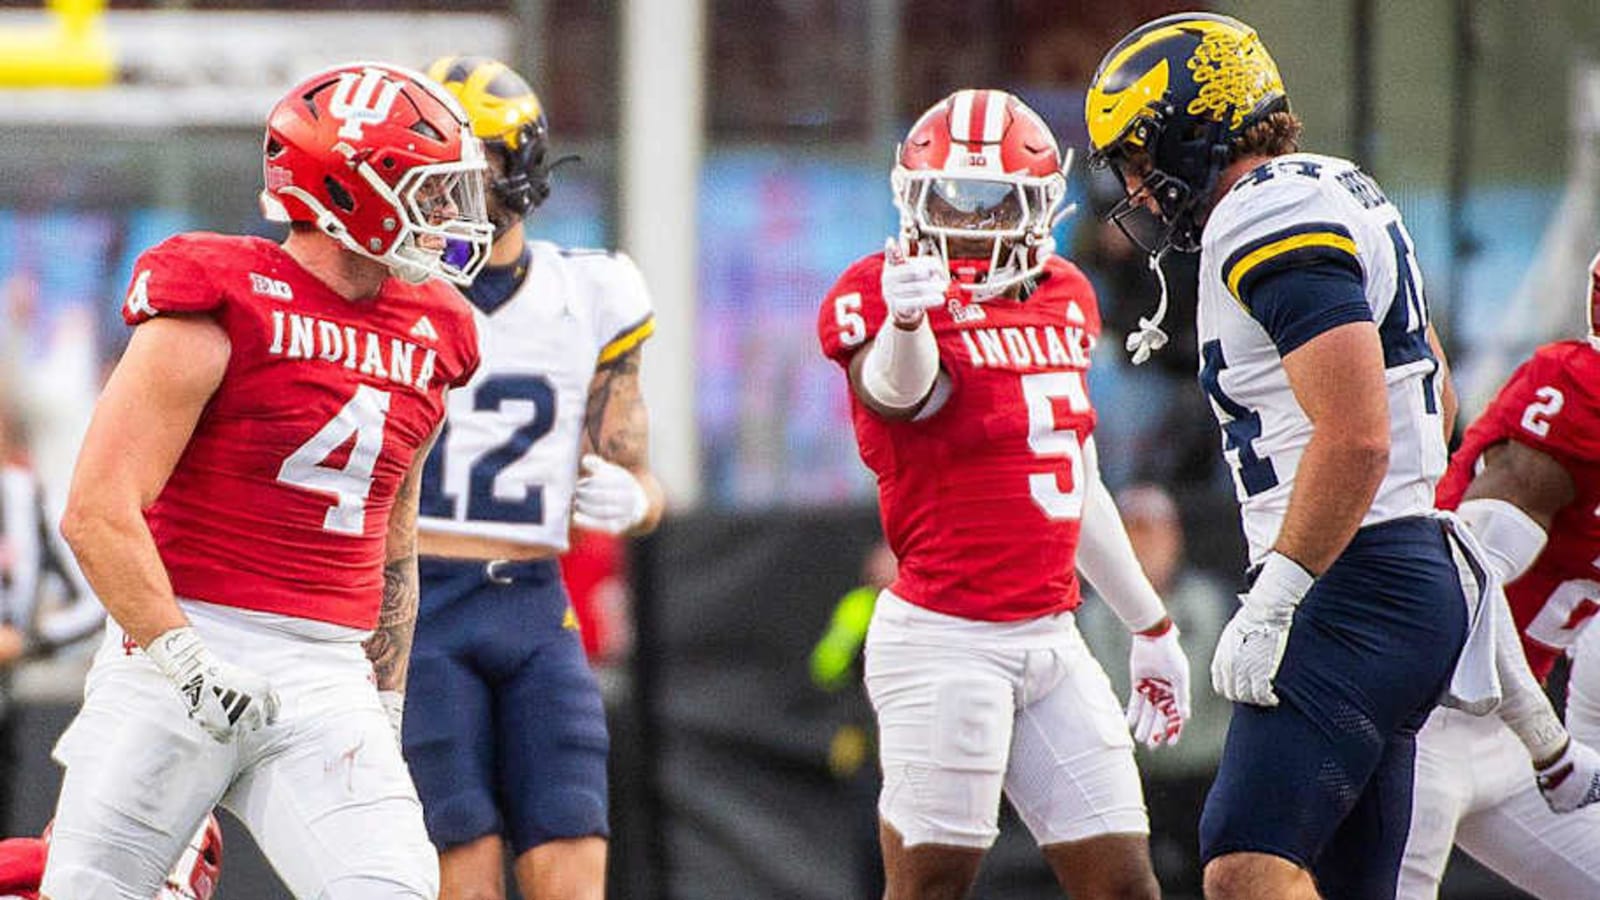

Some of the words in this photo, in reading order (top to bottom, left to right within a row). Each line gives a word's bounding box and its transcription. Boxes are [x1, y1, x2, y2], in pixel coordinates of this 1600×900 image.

[127, 270, 159, 315] 4
[834, 292, 867, 347] 5
[269, 310, 437, 394] INDIANA
[1020, 371, 1092, 520] 5
[1520, 386, 1564, 438] 2
[276, 383, 391, 536] 4
